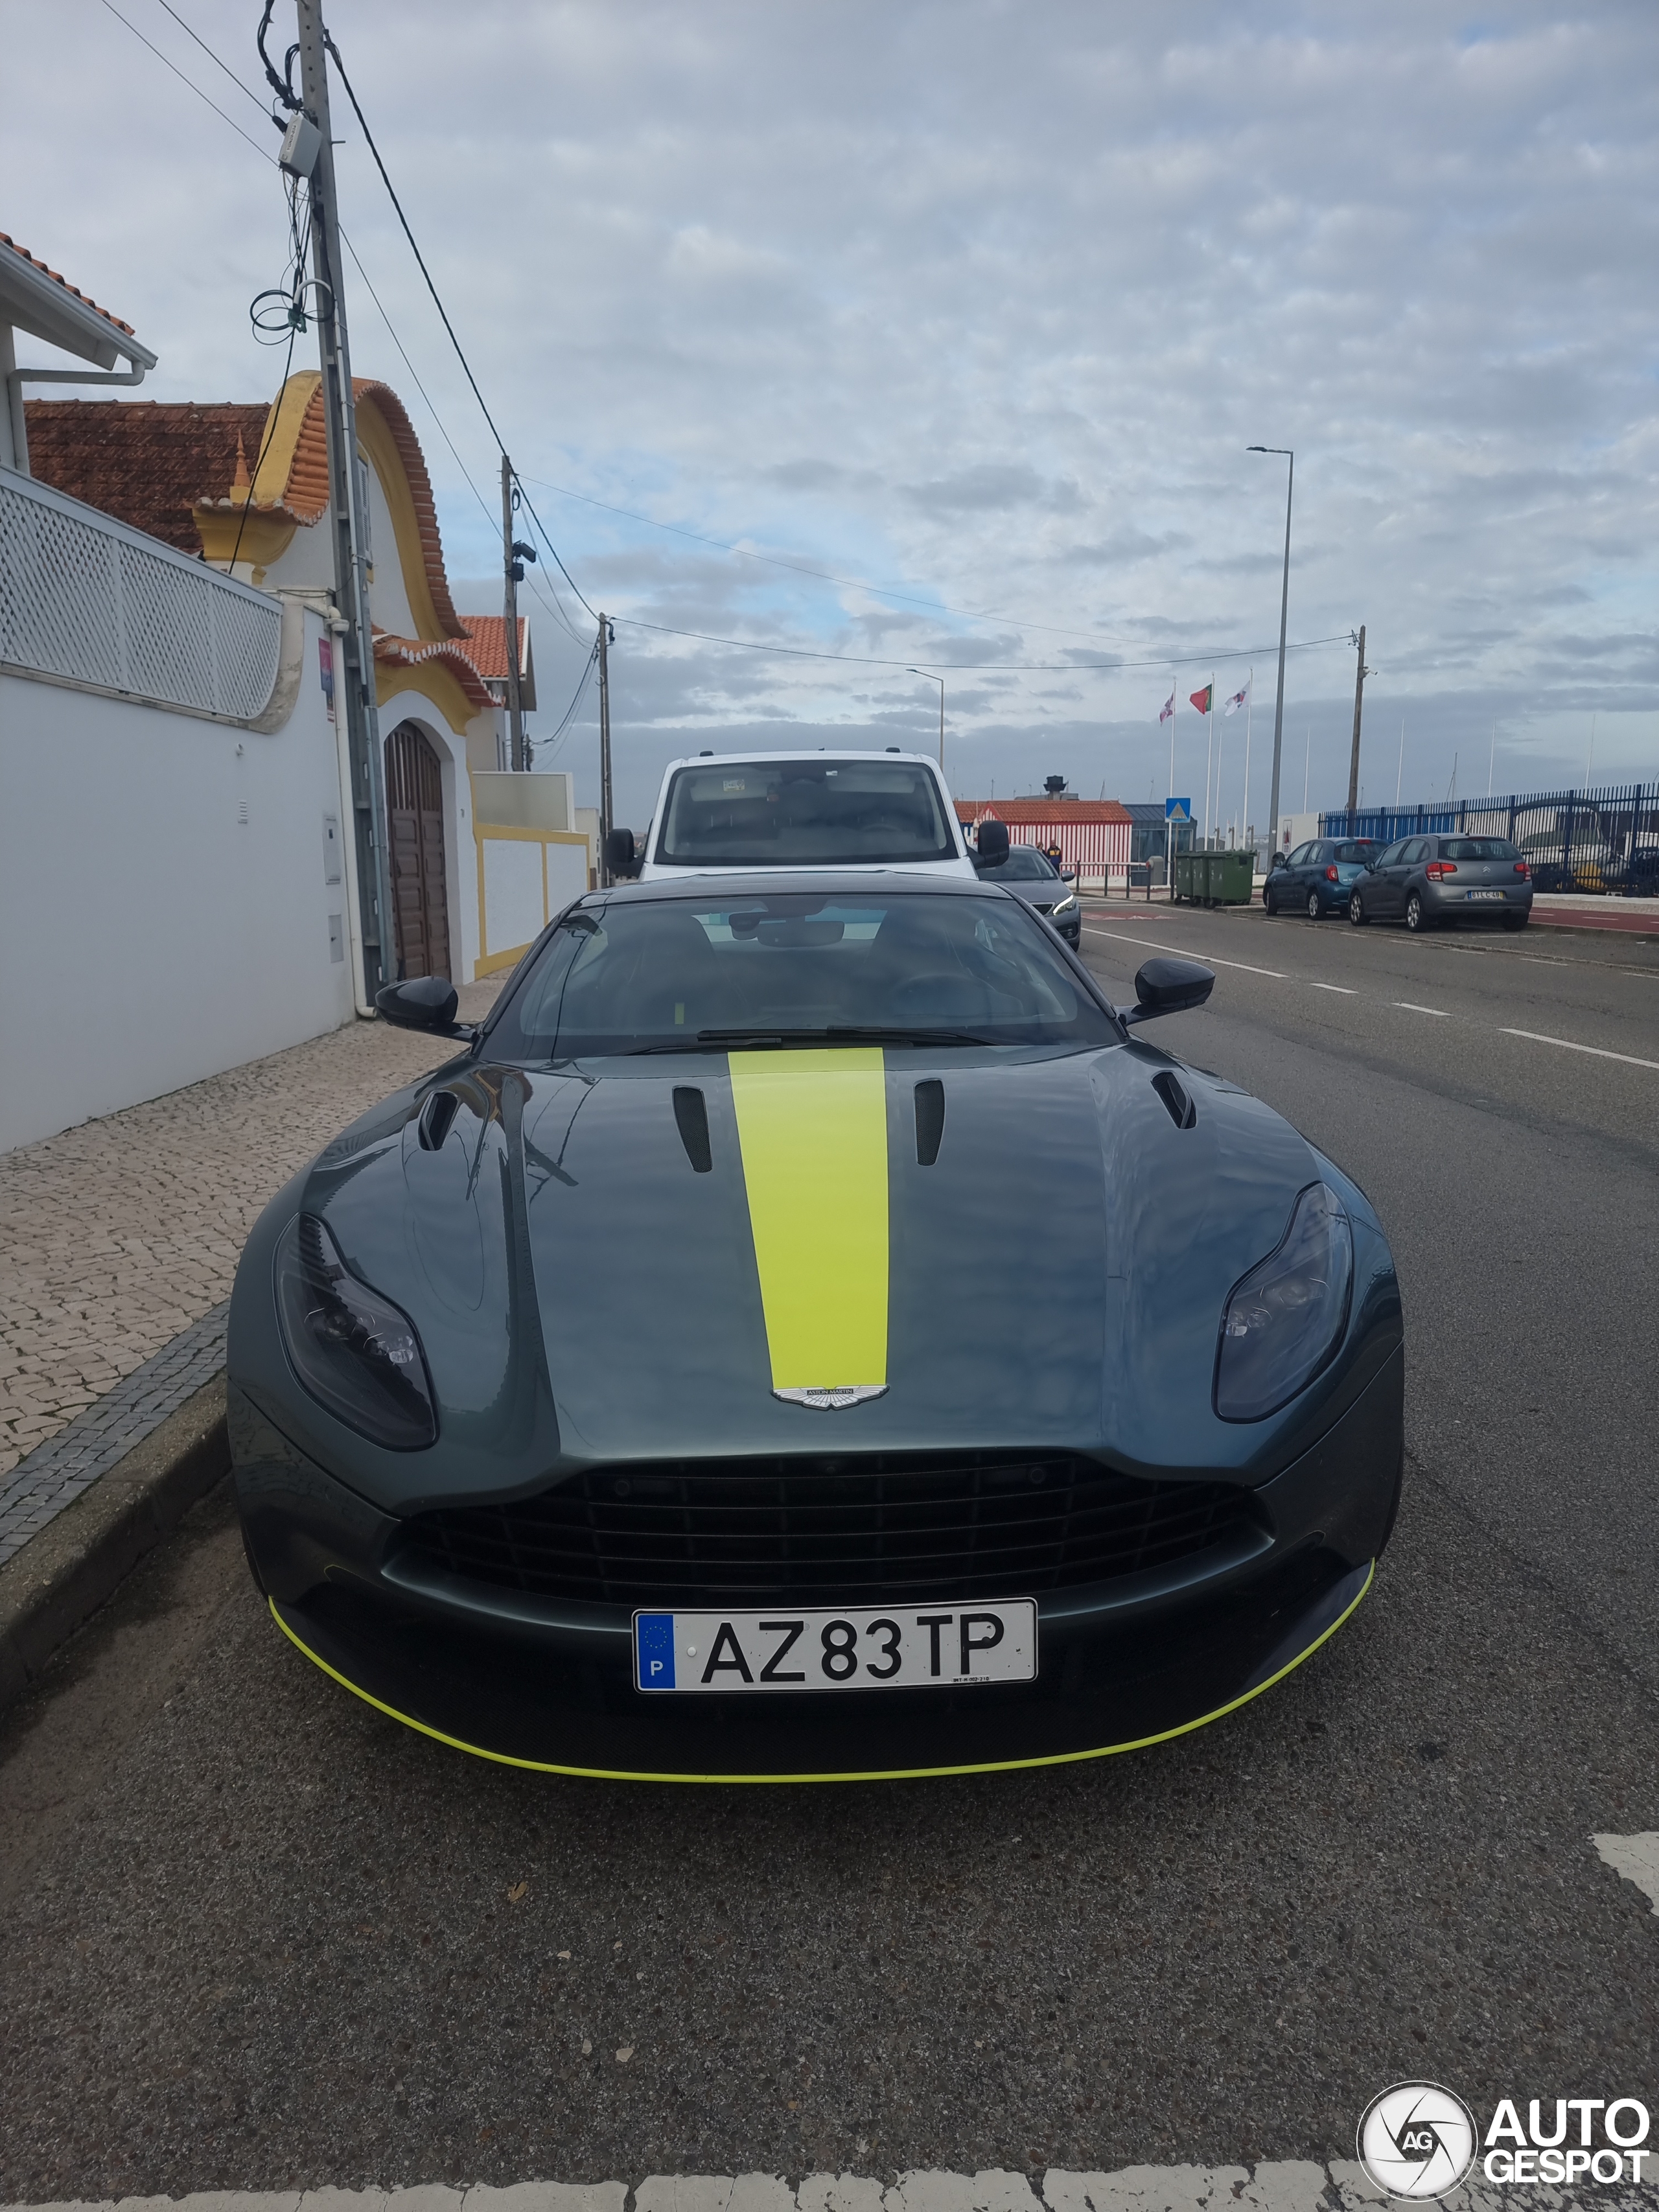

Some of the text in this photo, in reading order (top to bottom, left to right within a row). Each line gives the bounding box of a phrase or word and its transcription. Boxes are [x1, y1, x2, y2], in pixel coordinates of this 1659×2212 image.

[650, 1660, 664, 1677] P
[700, 1612, 1004, 1684] AZ 83 TP
